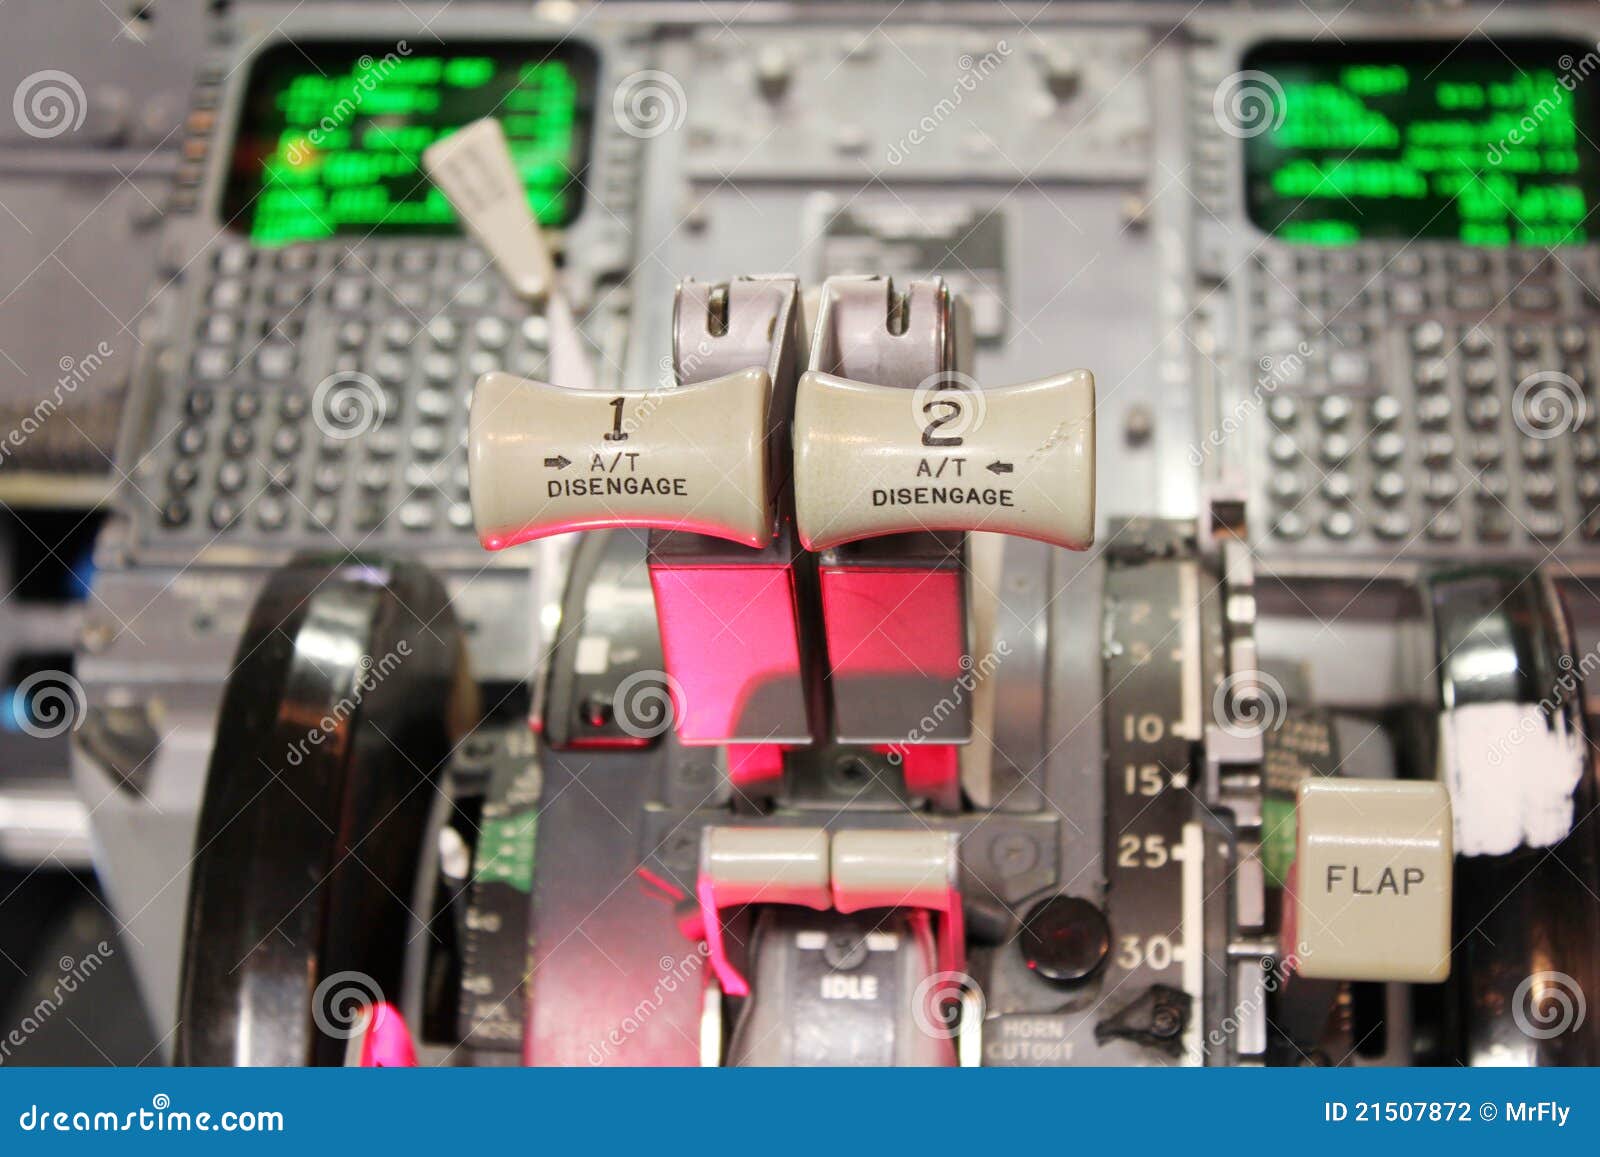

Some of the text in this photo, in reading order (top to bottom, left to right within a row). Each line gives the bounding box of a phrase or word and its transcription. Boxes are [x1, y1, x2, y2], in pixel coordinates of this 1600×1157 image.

[603, 397, 629, 441] 1
[921, 400, 963, 446] 2
[590, 452, 640, 473] A/T
[916, 457, 967, 478] A/T
[547, 477, 688, 498] DISENGAGE
[872, 487, 1014, 507] DISENGAGE
[1123, 713, 1164, 743] 10
[1124, 763, 1164, 796] 15
[1118, 834, 1168, 868] 25
[1326, 865, 1425, 895] FLAP
[1117, 935, 1172, 970] 30
[821, 975, 878, 1000] IDLE
[1002, 1020, 1064, 1039] HORN
[987, 1042, 1074, 1061] CUTOUT
